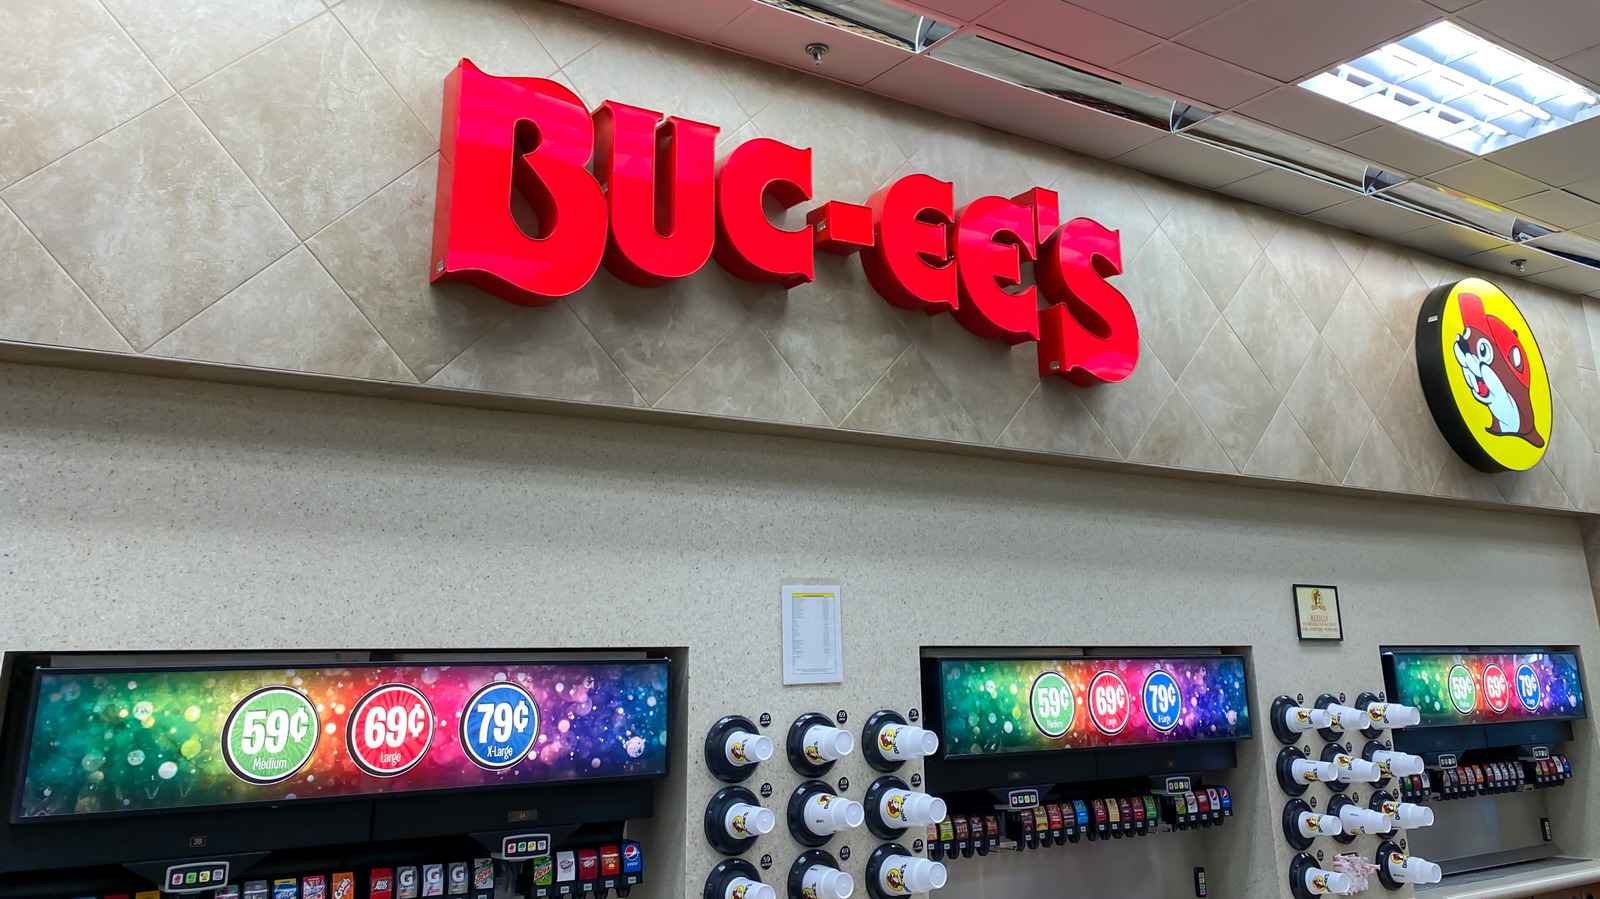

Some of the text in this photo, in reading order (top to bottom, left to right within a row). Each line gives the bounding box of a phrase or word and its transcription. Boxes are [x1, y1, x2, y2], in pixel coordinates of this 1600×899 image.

[1452, 675, 1472, 700] 59¢
[1487, 675, 1506, 698] 69¢
[1518, 673, 1537, 697] 79¢
[1037, 685, 1070, 718] 59¢
[1095, 684, 1125, 716] 69¢
[1149, 683, 1176, 713] 79¢
[241, 705, 309, 755] 59¢
[364, 703, 425, 749] 69¢
[477, 700, 529, 744] 79¢
[253, 756, 287, 770] Medium
[380, 750, 401, 766] Large
[487, 744, 513, 759] X-Large
[400, 870, 413, 886] G
[427, 868, 440, 883] G
[452, 866, 464, 882] G
